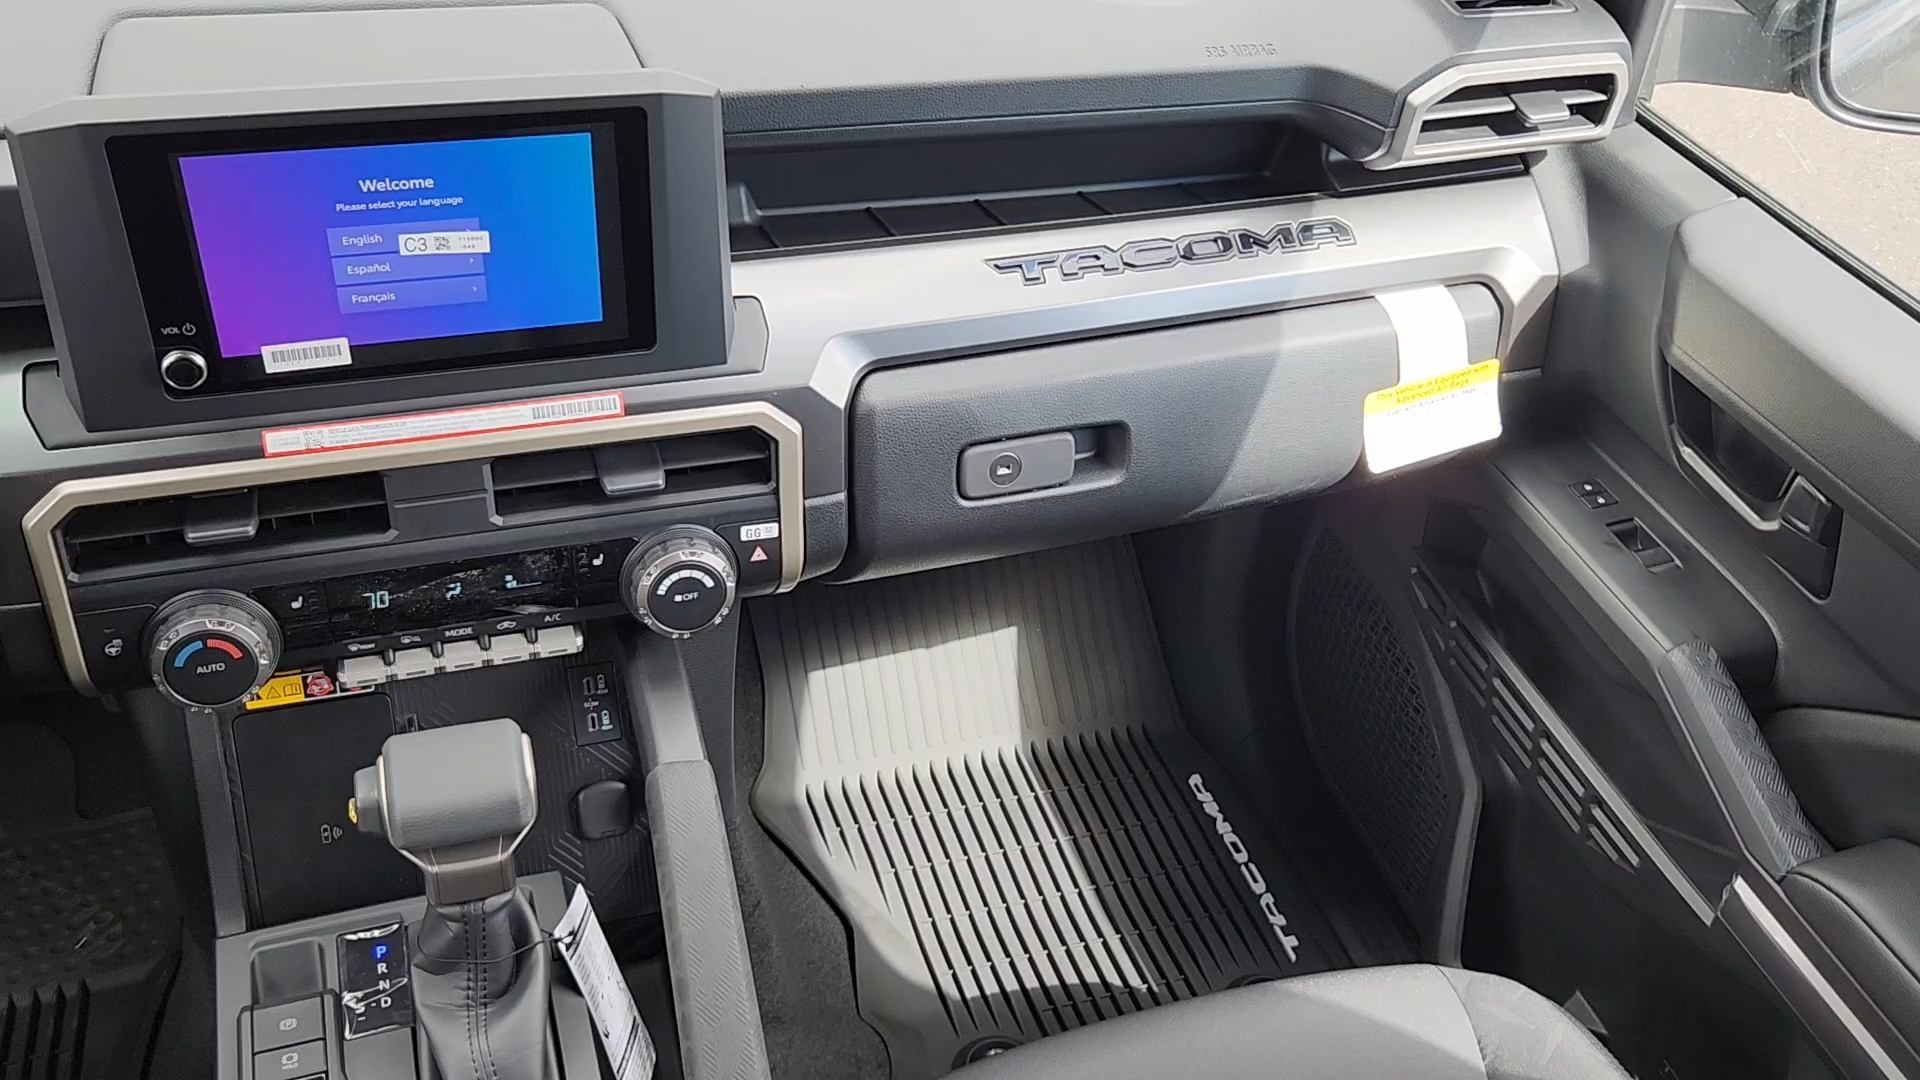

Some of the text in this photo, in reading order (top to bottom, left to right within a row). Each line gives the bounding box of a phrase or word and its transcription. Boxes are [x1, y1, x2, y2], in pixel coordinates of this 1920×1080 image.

[1230, 43, 1278, 57] AIRBAG
[358, 178, 434, 192] Welcome
[336, 196, 464, 212] Please select your language
[342, 233, 383, 247] English
[403, 236, 429, 253] C3
[981, 215, 1357, 286] TACOMA
[347, 262, 391, 275] Español
[351, 291, 396, 304] Français
[160, 327, 181, 336] VOL
[1395, 383, 1423, 396] Vehicle
[1473, 364, 1490, 374] with
[745, 527, 762, 539] GG
[362, 590, 389, 609] 70
[682, 592, 700, 602] OFF
[543, 613, 562, 622] A/C
[444, 627, 474, 637] MODE
[196, 662, 226, 675] AUTO
[1188, 773, 1299, 963] TACOMA
[376, 945, 387, 959] P
[376, 962, 389, 975] R
[379, 979, 391, 991] N
[380, 996, 392, 1009] D
